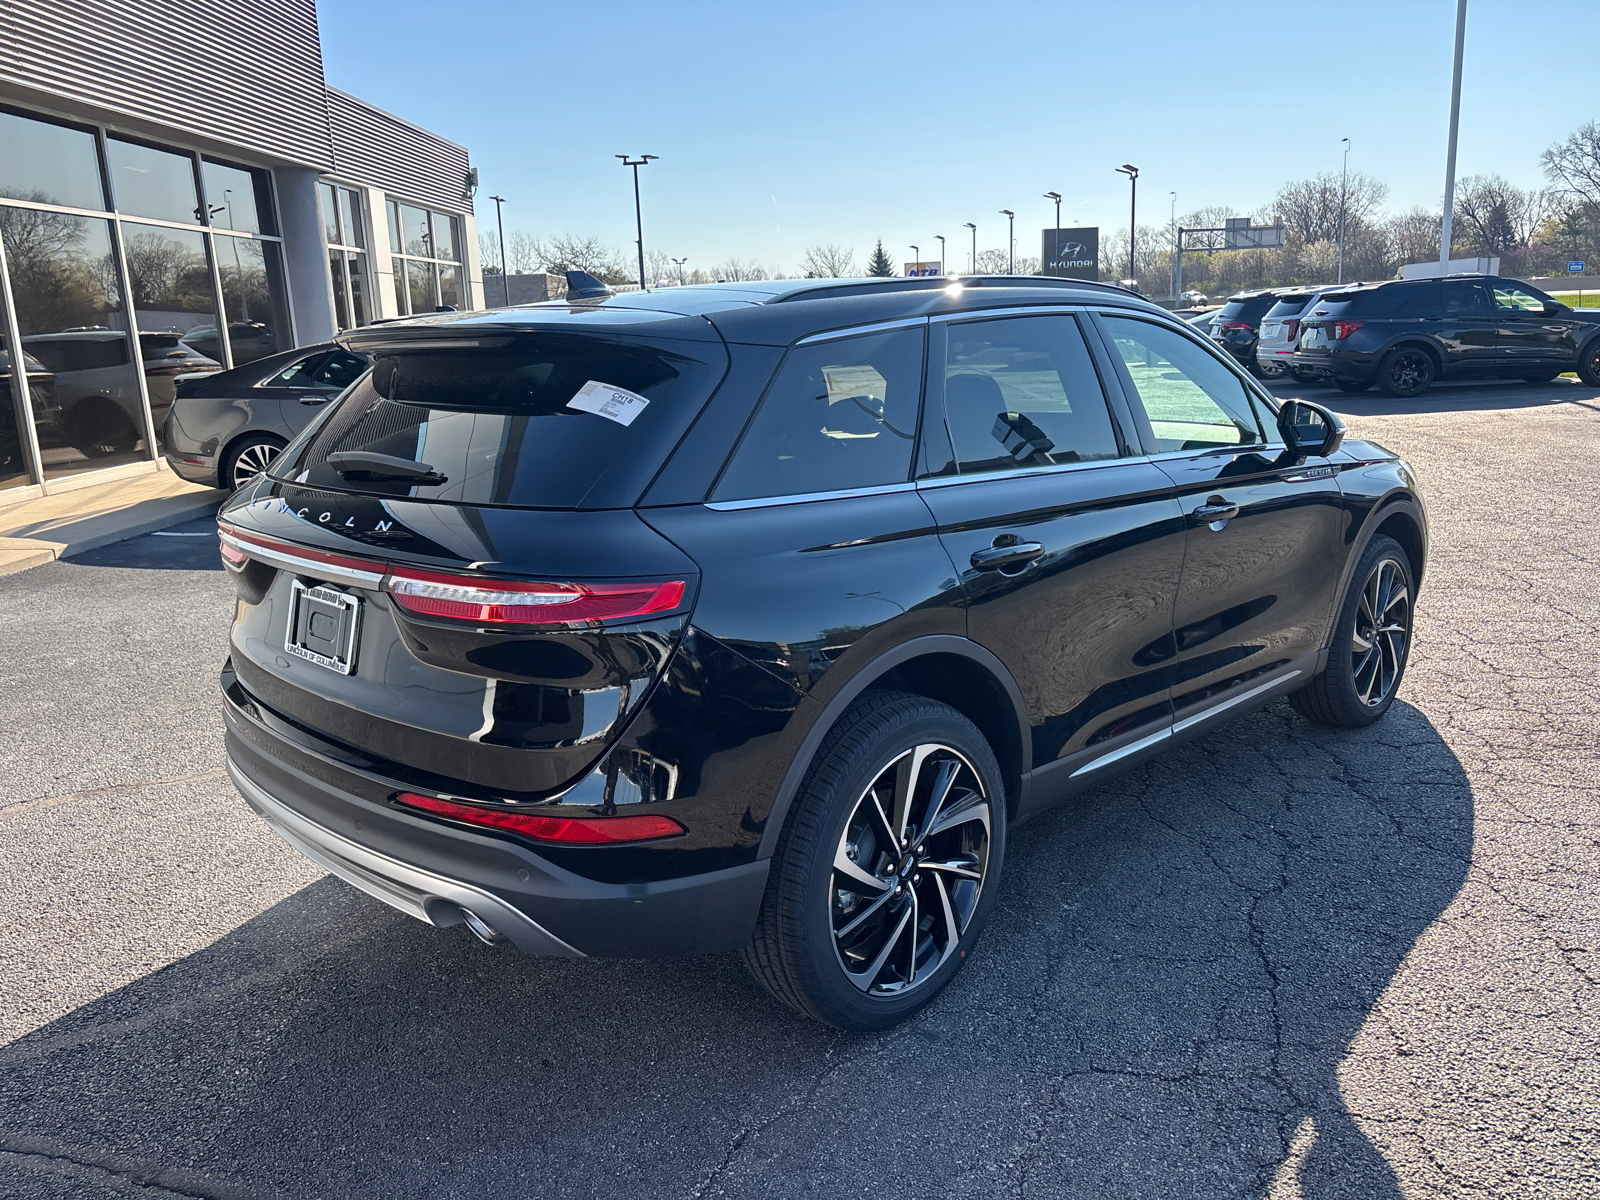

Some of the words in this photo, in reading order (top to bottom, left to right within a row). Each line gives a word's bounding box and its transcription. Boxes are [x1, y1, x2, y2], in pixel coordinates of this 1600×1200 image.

[1050, 260, 1093, 269] HYUNDAI
[612, 392, 634, 404] CH18
[250, 498, 393, 532] LINCOLN
[308, 653, 316, 661] OF
